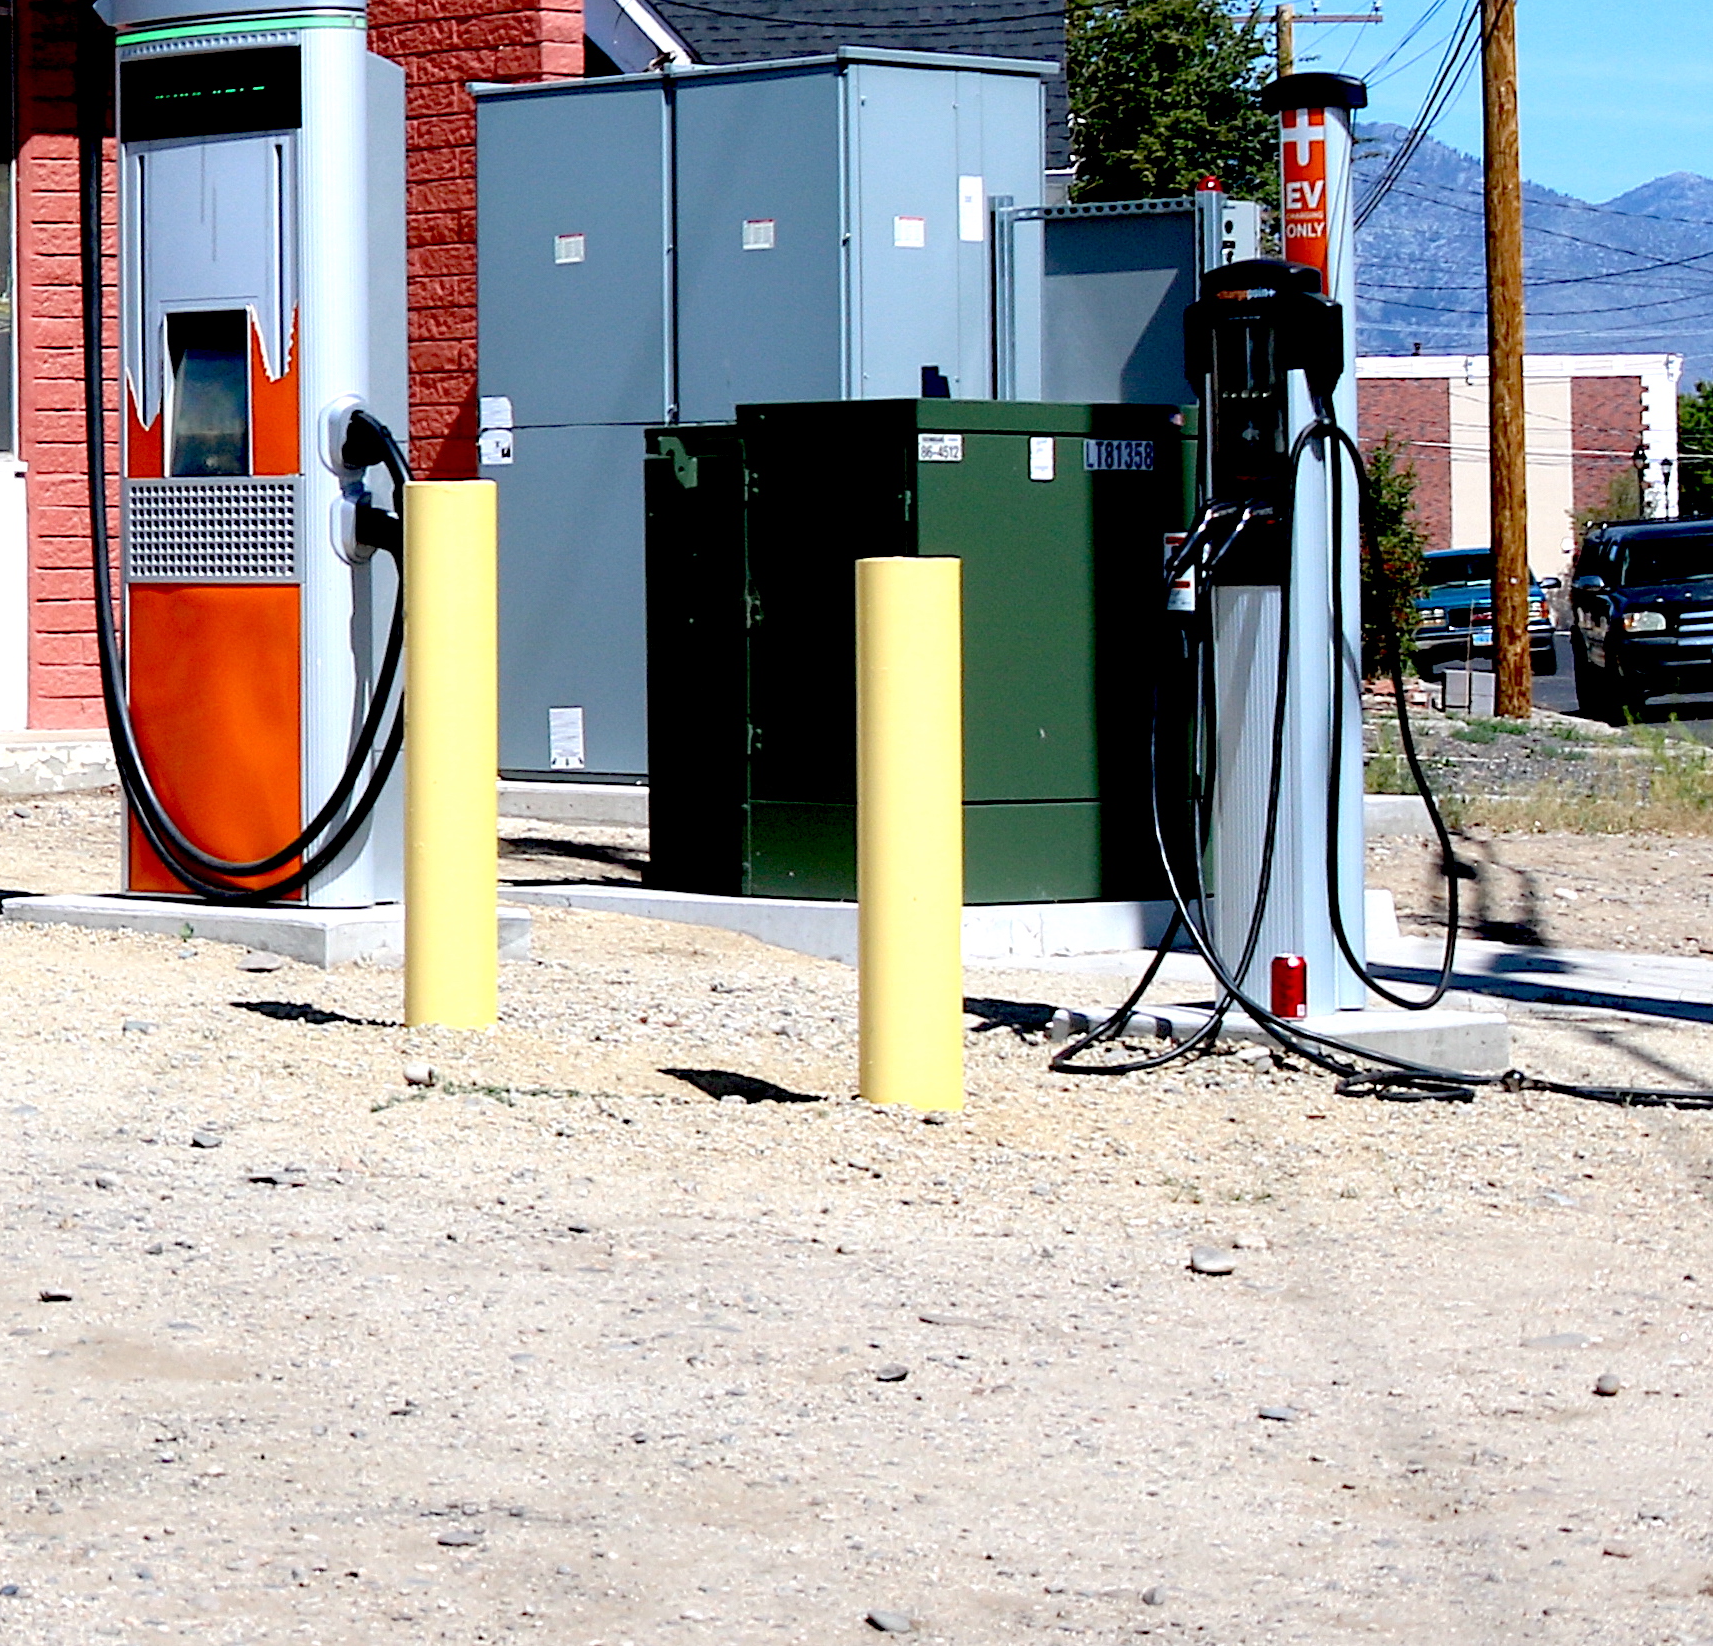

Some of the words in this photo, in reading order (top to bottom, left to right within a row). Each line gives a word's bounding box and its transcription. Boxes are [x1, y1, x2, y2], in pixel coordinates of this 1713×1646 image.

[1286, 180, 1324, 210] EV
[1286, 221, 1326, 239] ONLY
[920, 444, 959, 460] 86-4512
[1086, 440, 1153, 470] LT81358
